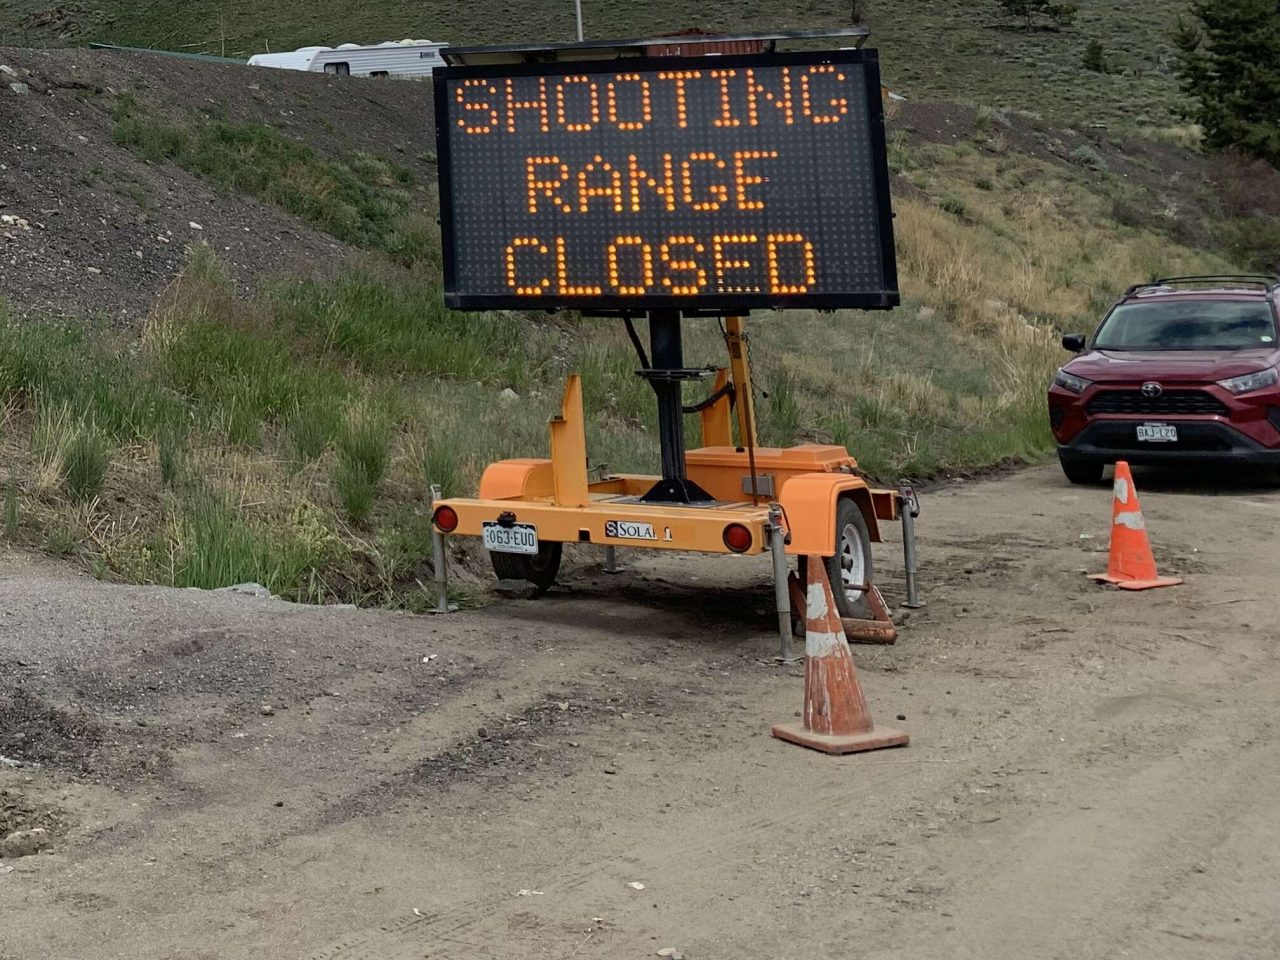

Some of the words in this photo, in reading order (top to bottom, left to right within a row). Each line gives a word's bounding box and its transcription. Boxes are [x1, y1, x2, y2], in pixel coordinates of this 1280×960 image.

[455, 65, 848, 134] SHOOTING
[526, 151, 778, 214] RANGE
[505, 234, 816, 295] CLOSED
